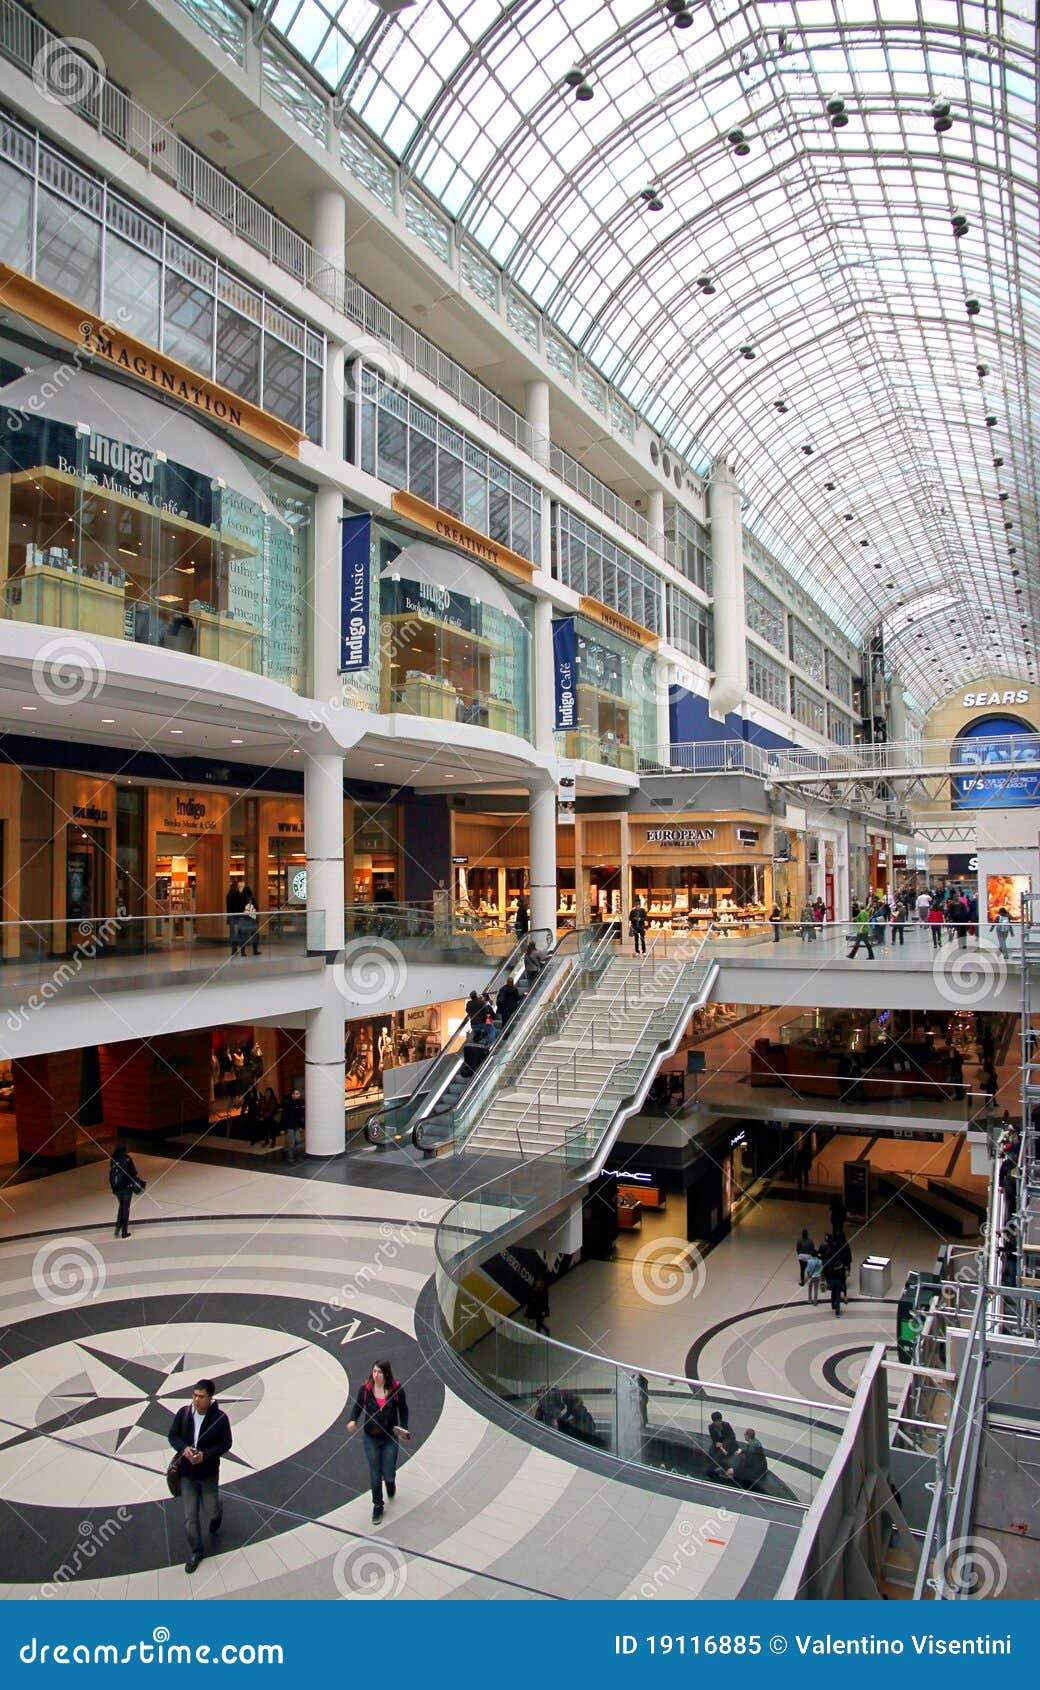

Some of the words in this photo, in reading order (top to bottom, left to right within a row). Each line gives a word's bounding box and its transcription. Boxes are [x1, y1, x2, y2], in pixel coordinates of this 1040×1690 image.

[84, 326, 243, 427] IMAGINATION
[101, 472, 139, 499] Music
[152, 495, 180, 516] Café
[435, 520, 499, 564] CREATIVITY
[350, 563, 365, 613] Music
[562, 661, 571, 690] Café
[962, 689, 1030, 708] SEARS
[647, 829, 716, 842] EUROPEAN
